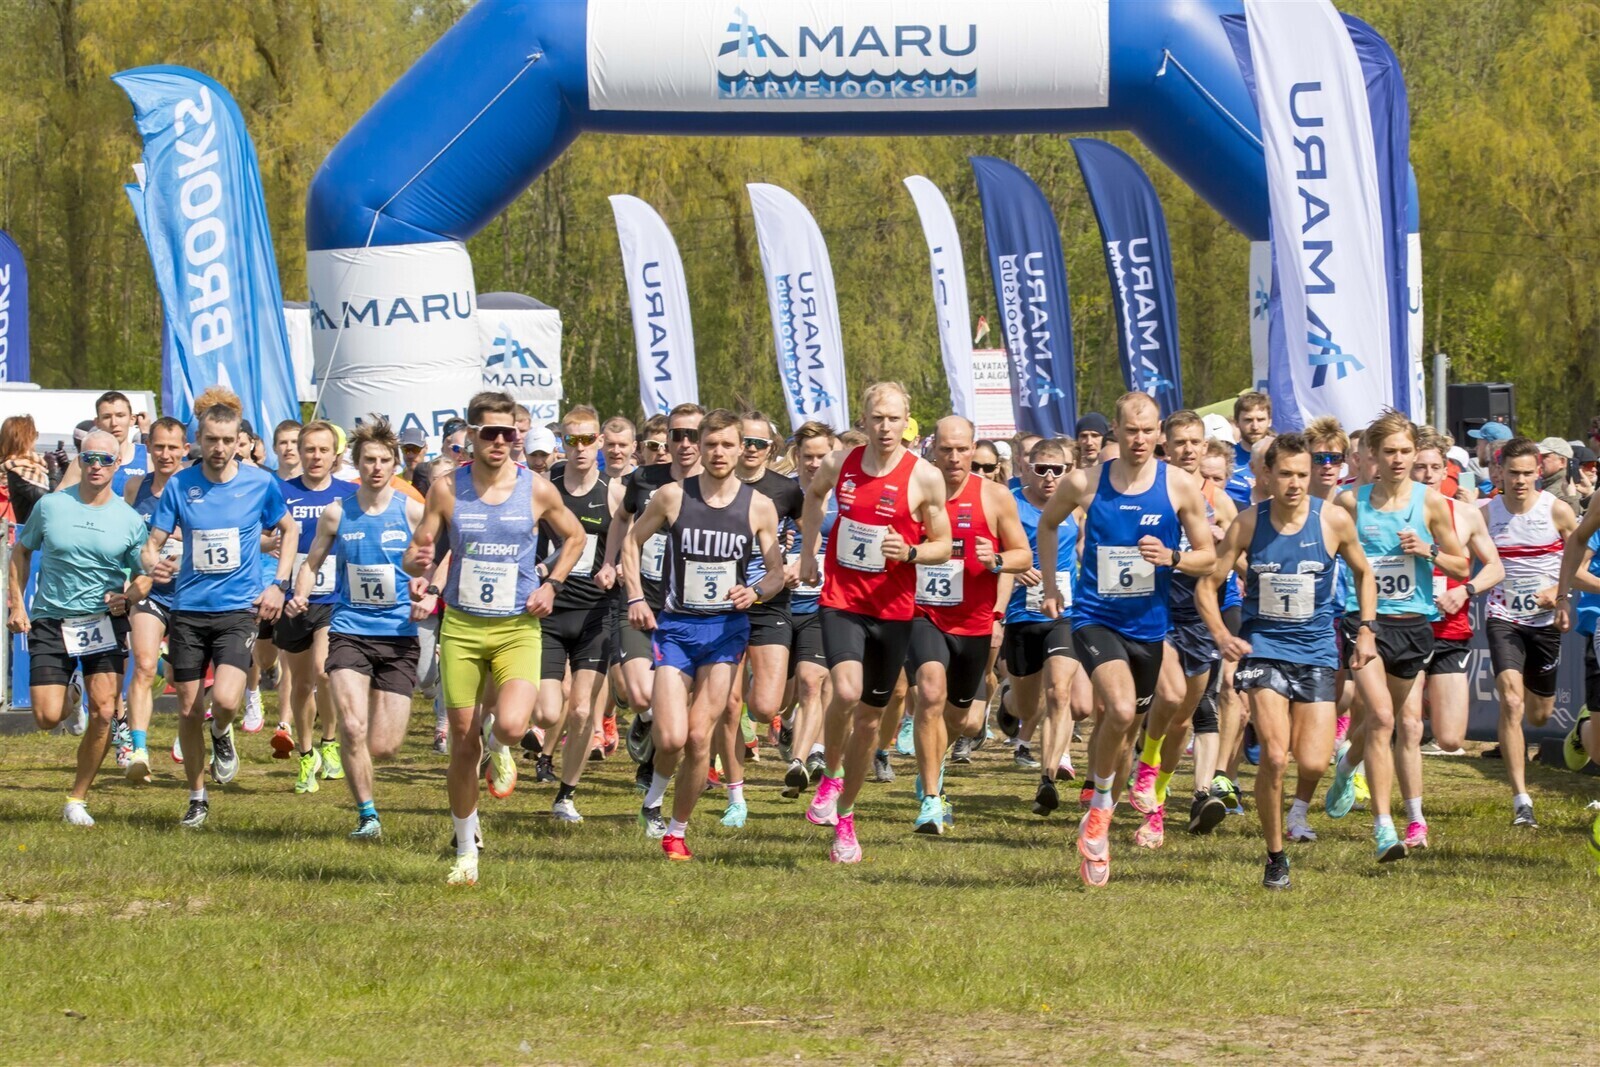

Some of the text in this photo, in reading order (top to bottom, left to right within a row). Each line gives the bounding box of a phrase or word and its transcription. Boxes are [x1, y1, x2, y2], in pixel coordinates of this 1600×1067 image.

[799, 24, 977, 57] MARU
[724, 77, 968, 98] JÄRVEJOOKSUD
[342, 291, 471, 328] MARU
[482, 373, 553, 387] MARU
[478, 543, 519, 555] TERRAT
[681, 528, 747, 560] ALTIUS
[853, 543, 866, 560] 4
[204, 547, 229, 565] 13
[1119, 567, 1133, 588] 6
[360, 583, 384, 599] 14
[480, 583, 494, 603] 8
[704, 582, 717, 599] 3
[926, 578, 951, 596] 43
[1280, 595, 1289, 612] 1
[76, 628, 103, 647] 34
